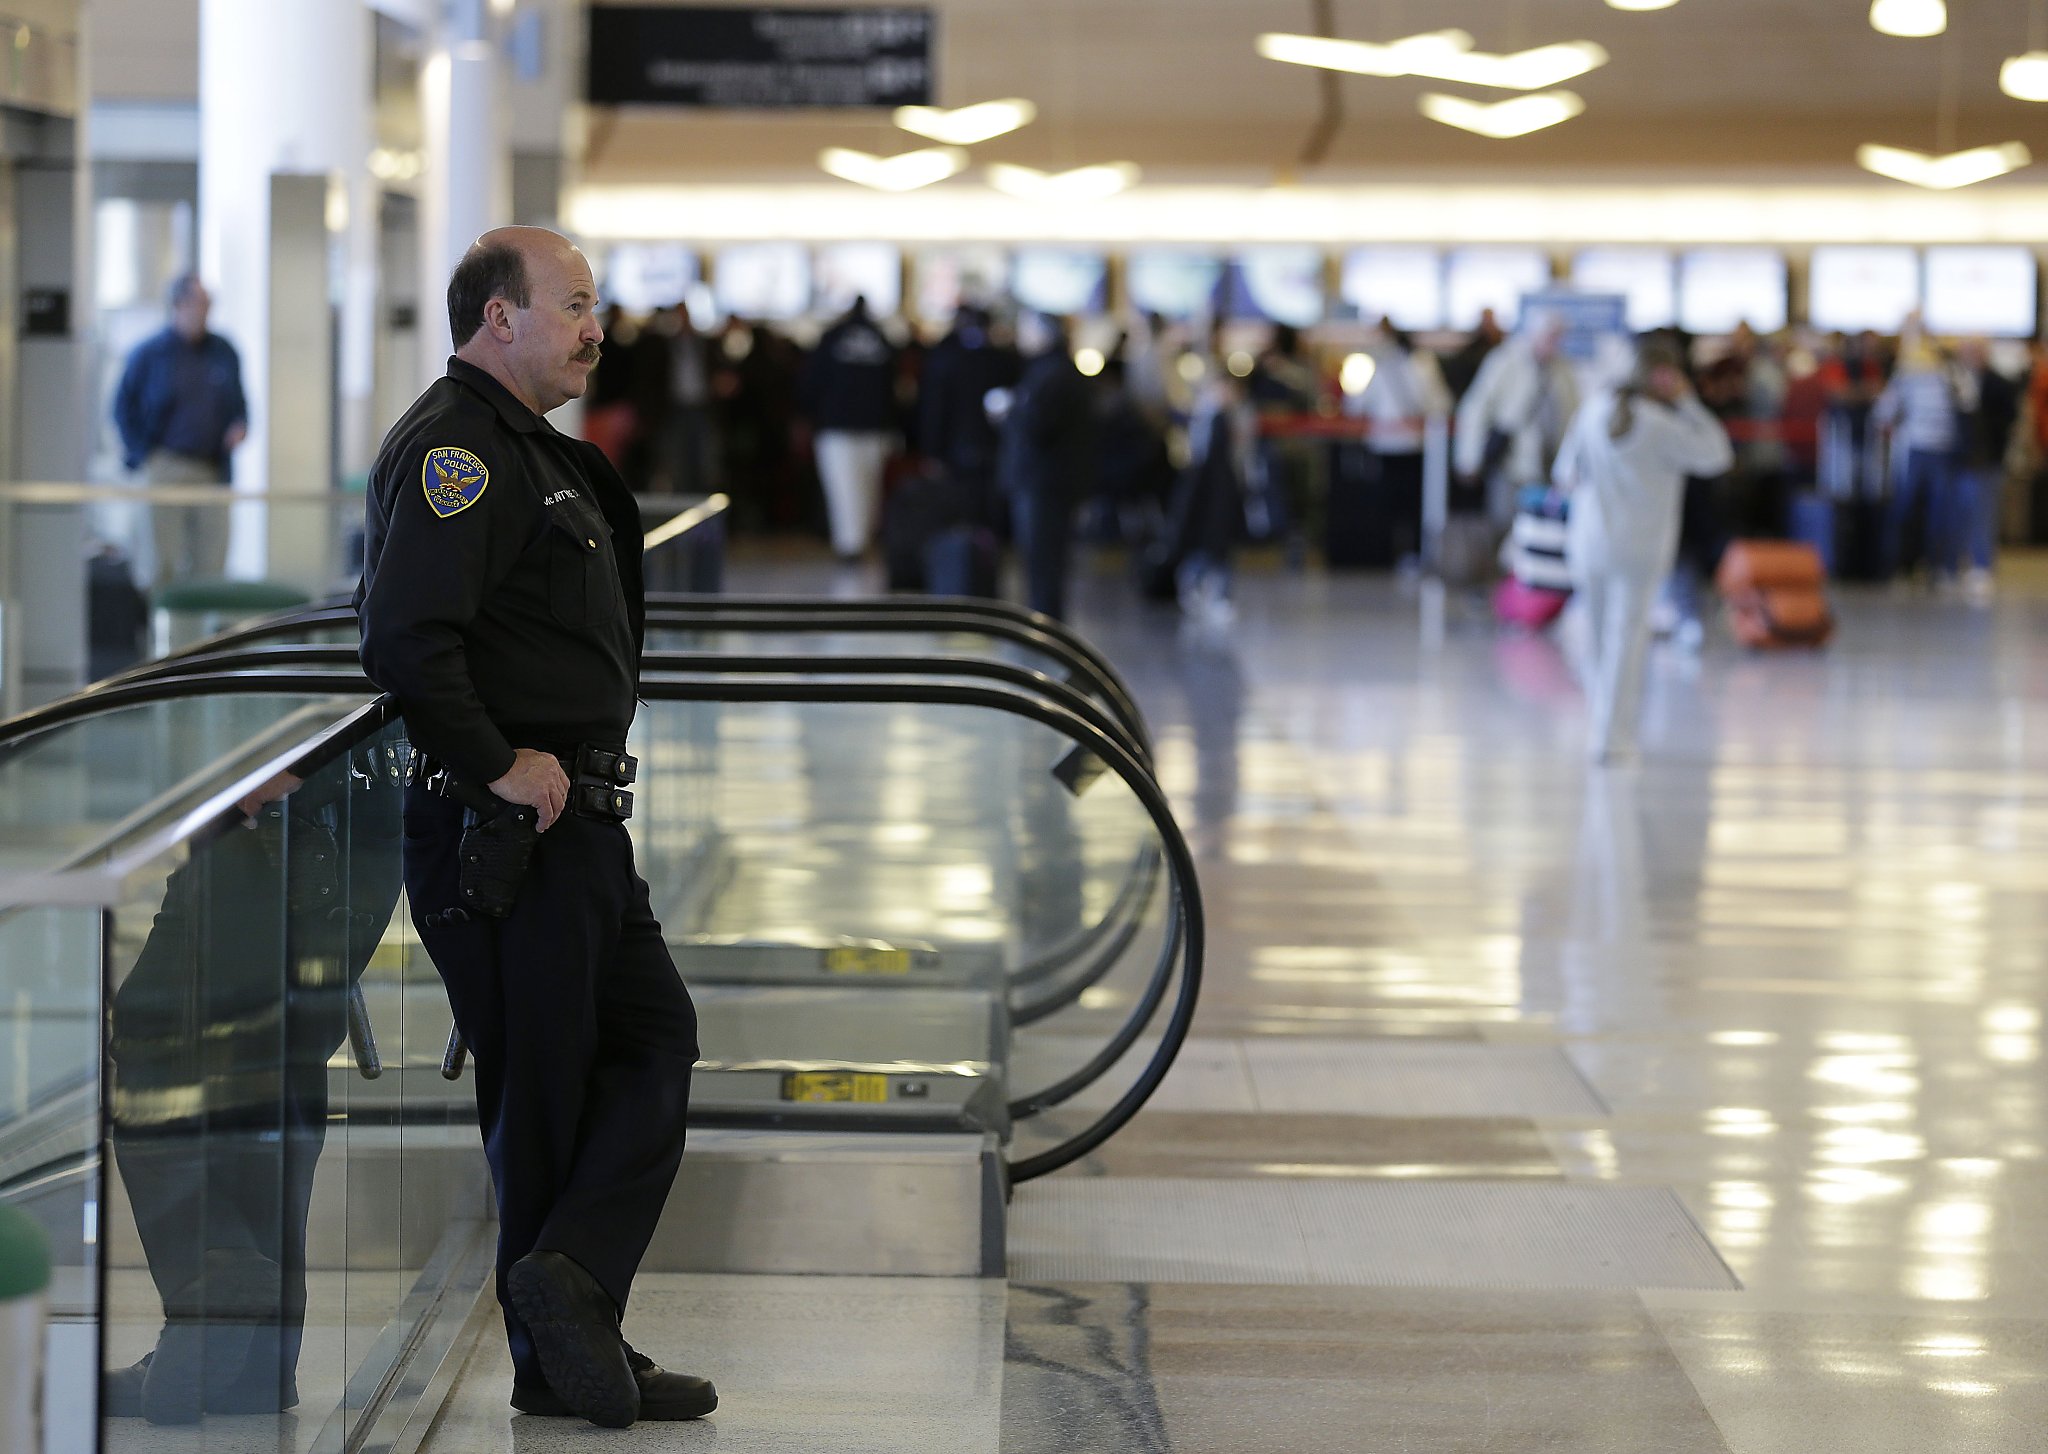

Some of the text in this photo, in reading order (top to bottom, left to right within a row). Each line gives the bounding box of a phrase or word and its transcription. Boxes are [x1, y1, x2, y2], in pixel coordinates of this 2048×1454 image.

[432, 450, 486, 475] SAN FRANCISCO
[443, 459, 473, 473] POLICE
